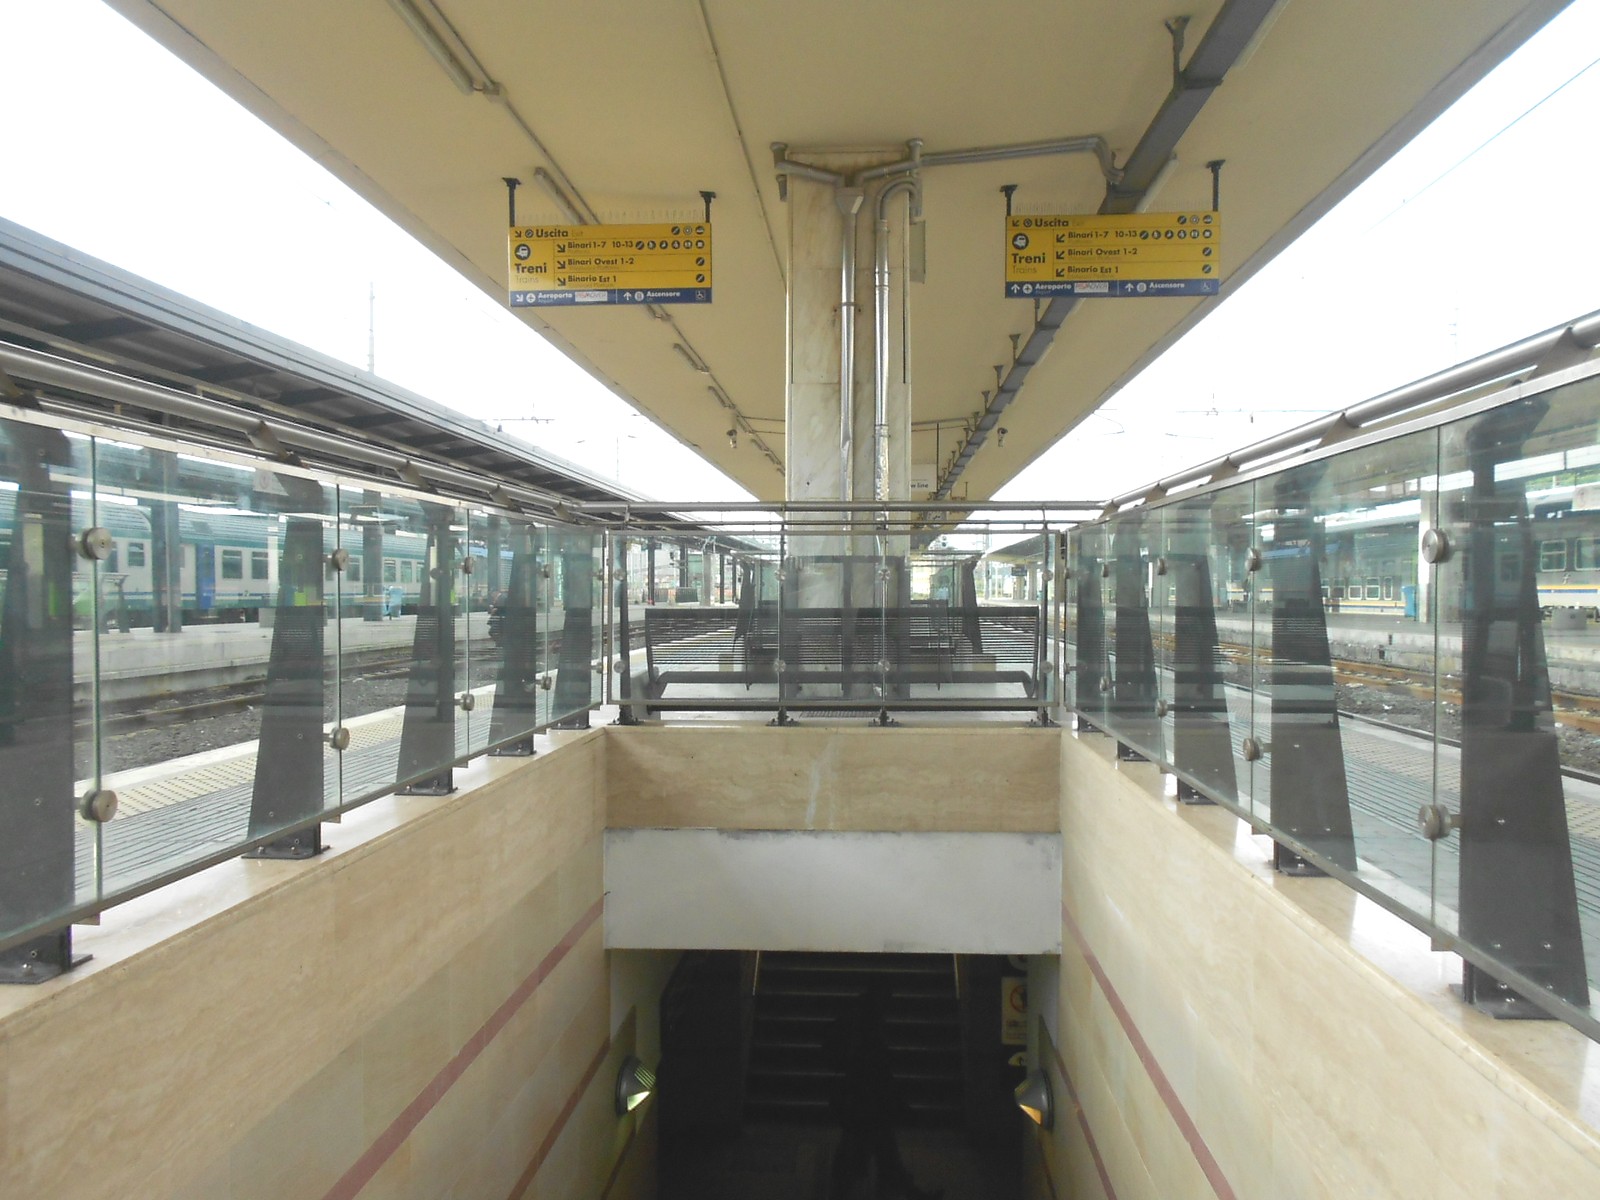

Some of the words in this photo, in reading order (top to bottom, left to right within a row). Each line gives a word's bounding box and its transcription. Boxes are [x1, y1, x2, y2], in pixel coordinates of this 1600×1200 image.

[1035, 218, 1069, 227] Uscita
[536, 228, 568, 238] Uscita
[1115, 230, 1137, 238] 10-13
[593, 241, 606, 249] 1-7
[1095, 248, 1120, 256] Ovest
[1011, 252, 1046, 263] Treni
[568, 258, 591, 266] Binari
[514, 262, 547, 273] Treni
[599, 275, 610, 283] Est
[1035, 283, 1072, 291] Aeroporto
